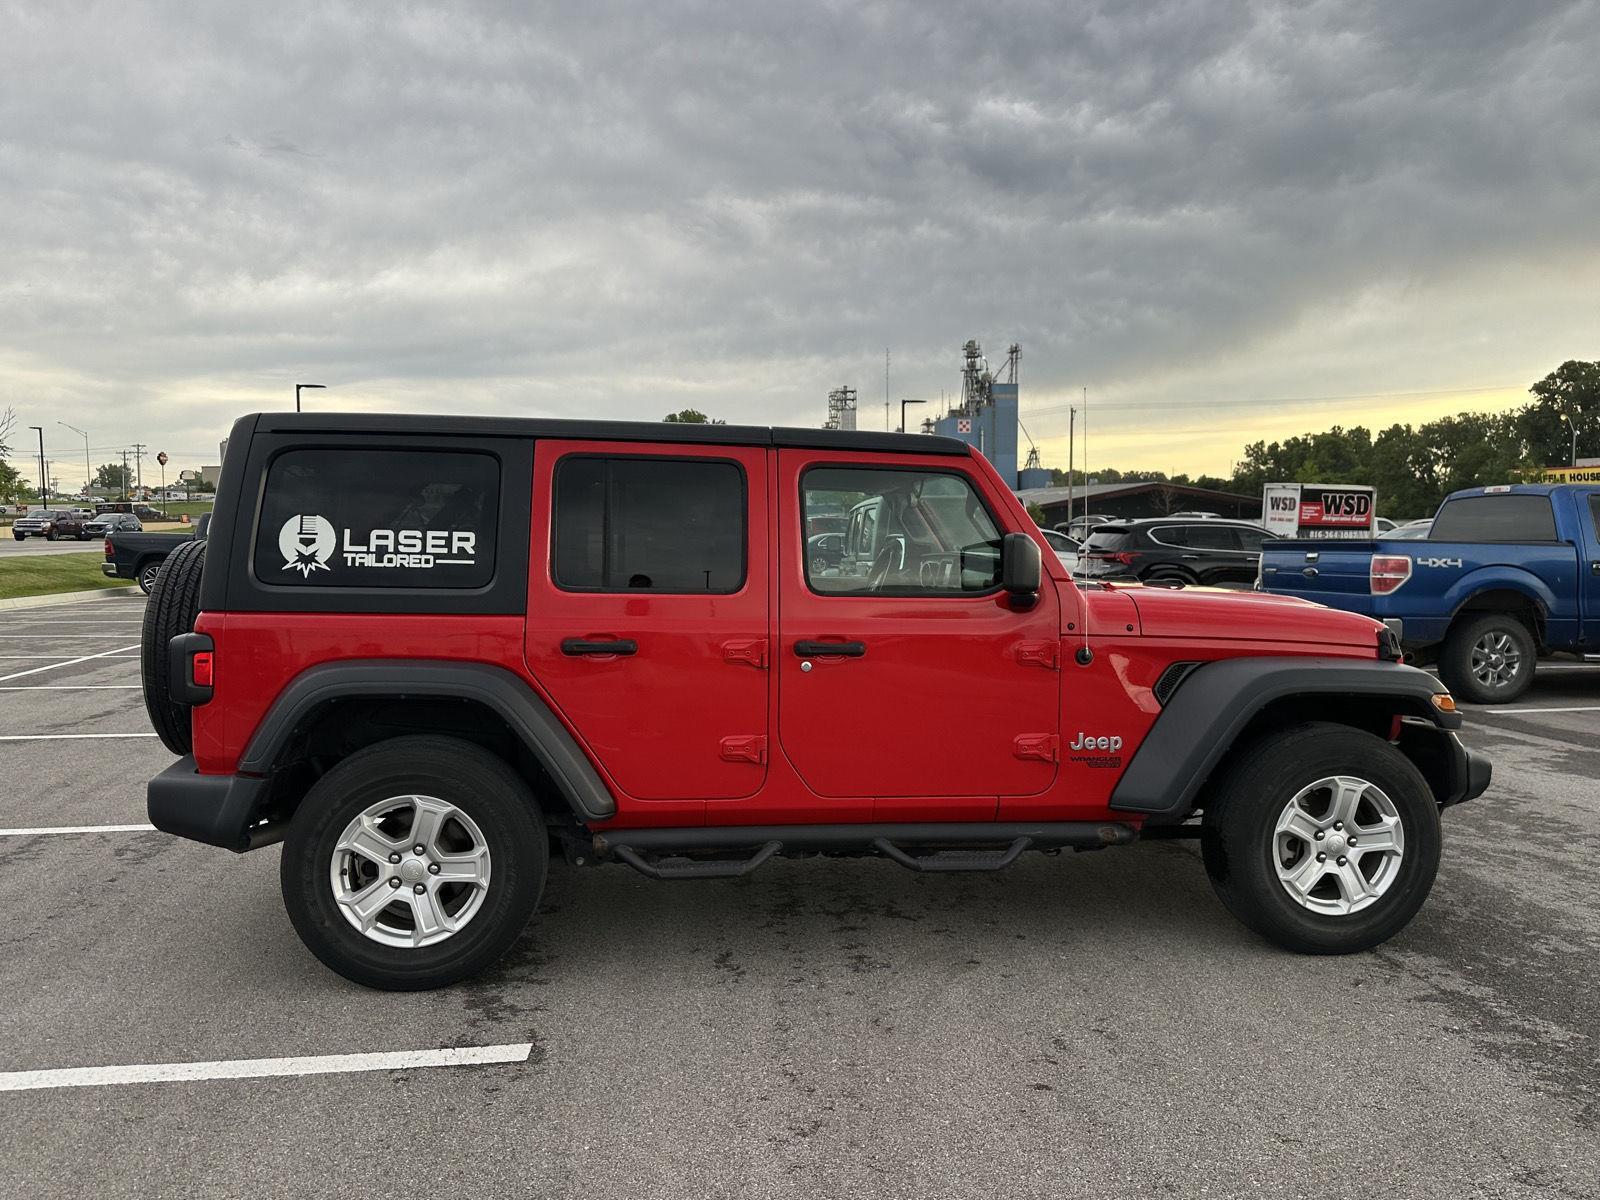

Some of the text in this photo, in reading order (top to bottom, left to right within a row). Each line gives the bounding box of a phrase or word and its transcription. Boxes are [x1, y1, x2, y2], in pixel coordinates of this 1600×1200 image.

[1569, 472, 1600, 482] HOUSE
[1270, 497, 1296, 512] WSD
[1322, 493, 1371, 517] WSD
[343, 528, 476, 555] LASER
[343, 552, 434, 568] TAILORED
[1069, 732, 1123, 753] Jeep
